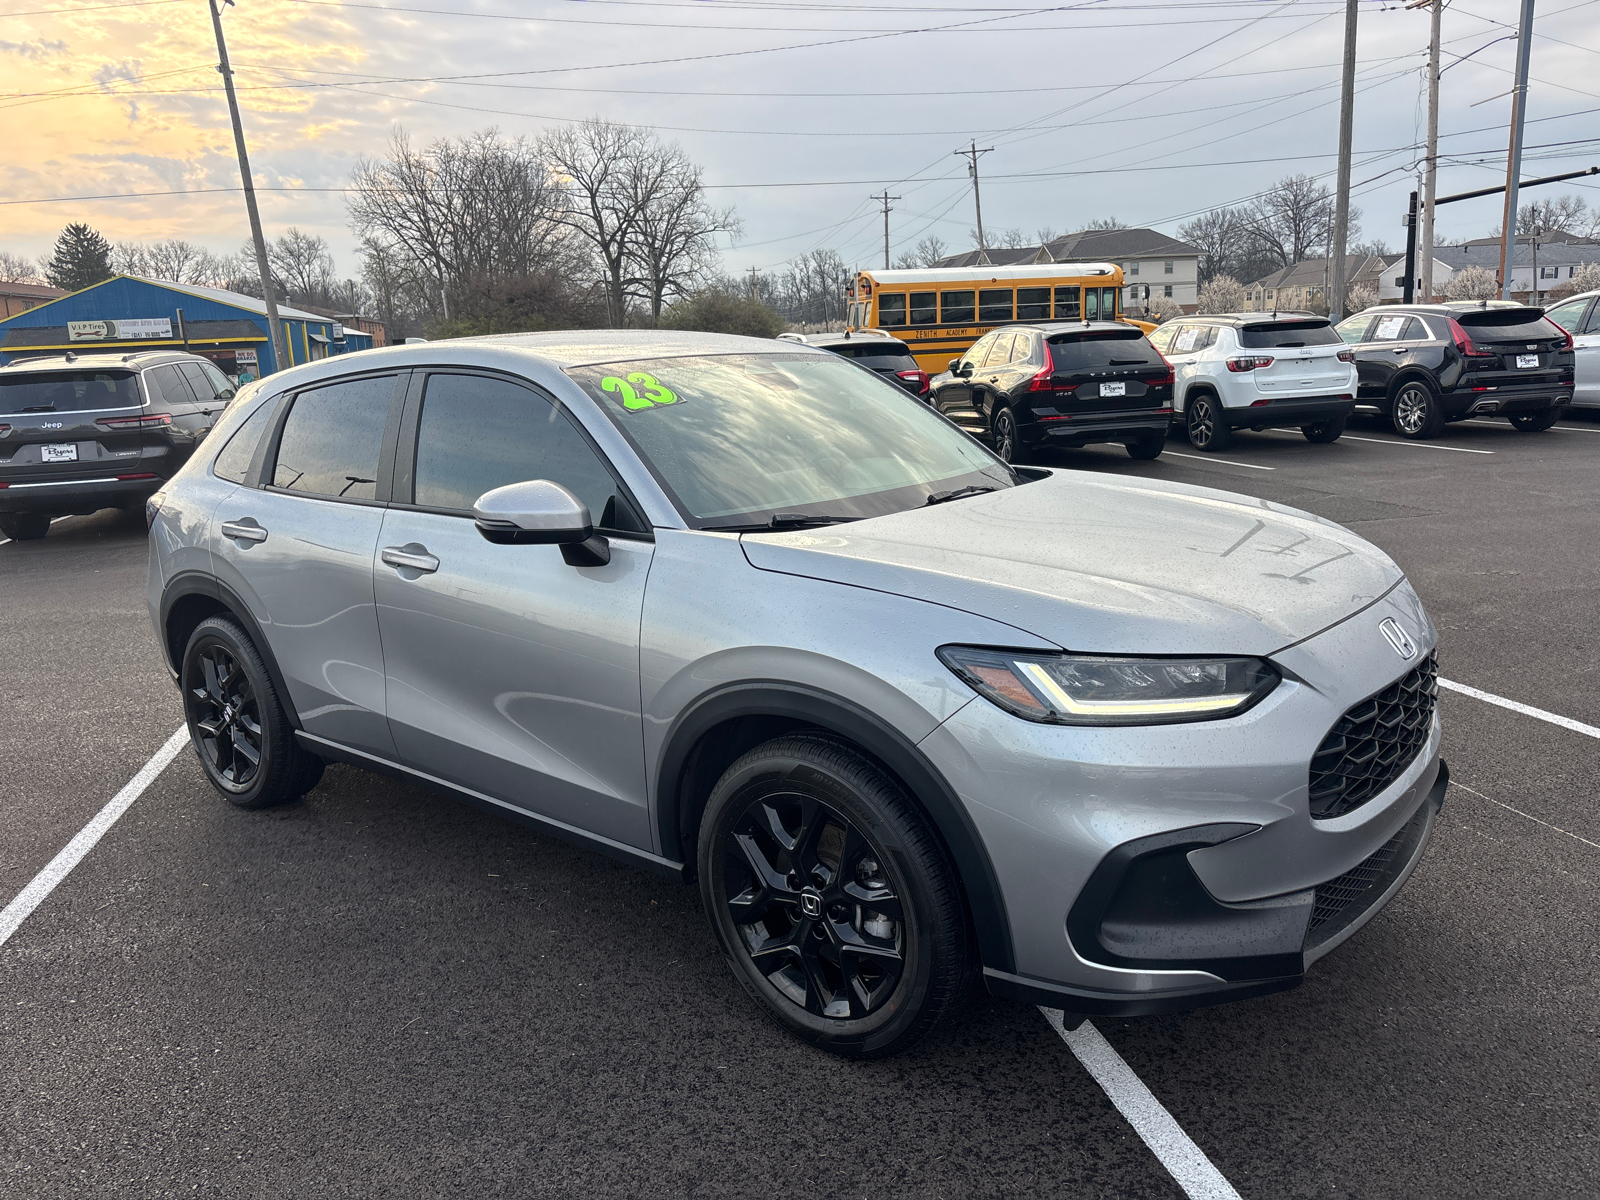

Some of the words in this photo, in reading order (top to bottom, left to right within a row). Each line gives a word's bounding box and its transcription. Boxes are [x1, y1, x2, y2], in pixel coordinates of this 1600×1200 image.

[915, 330, 938, 339] ZENITH
[945, 328, 968, 337] ACADEMY
[601, 372, 678, 410] 23
[41, 421, 63, 429] Jeep
